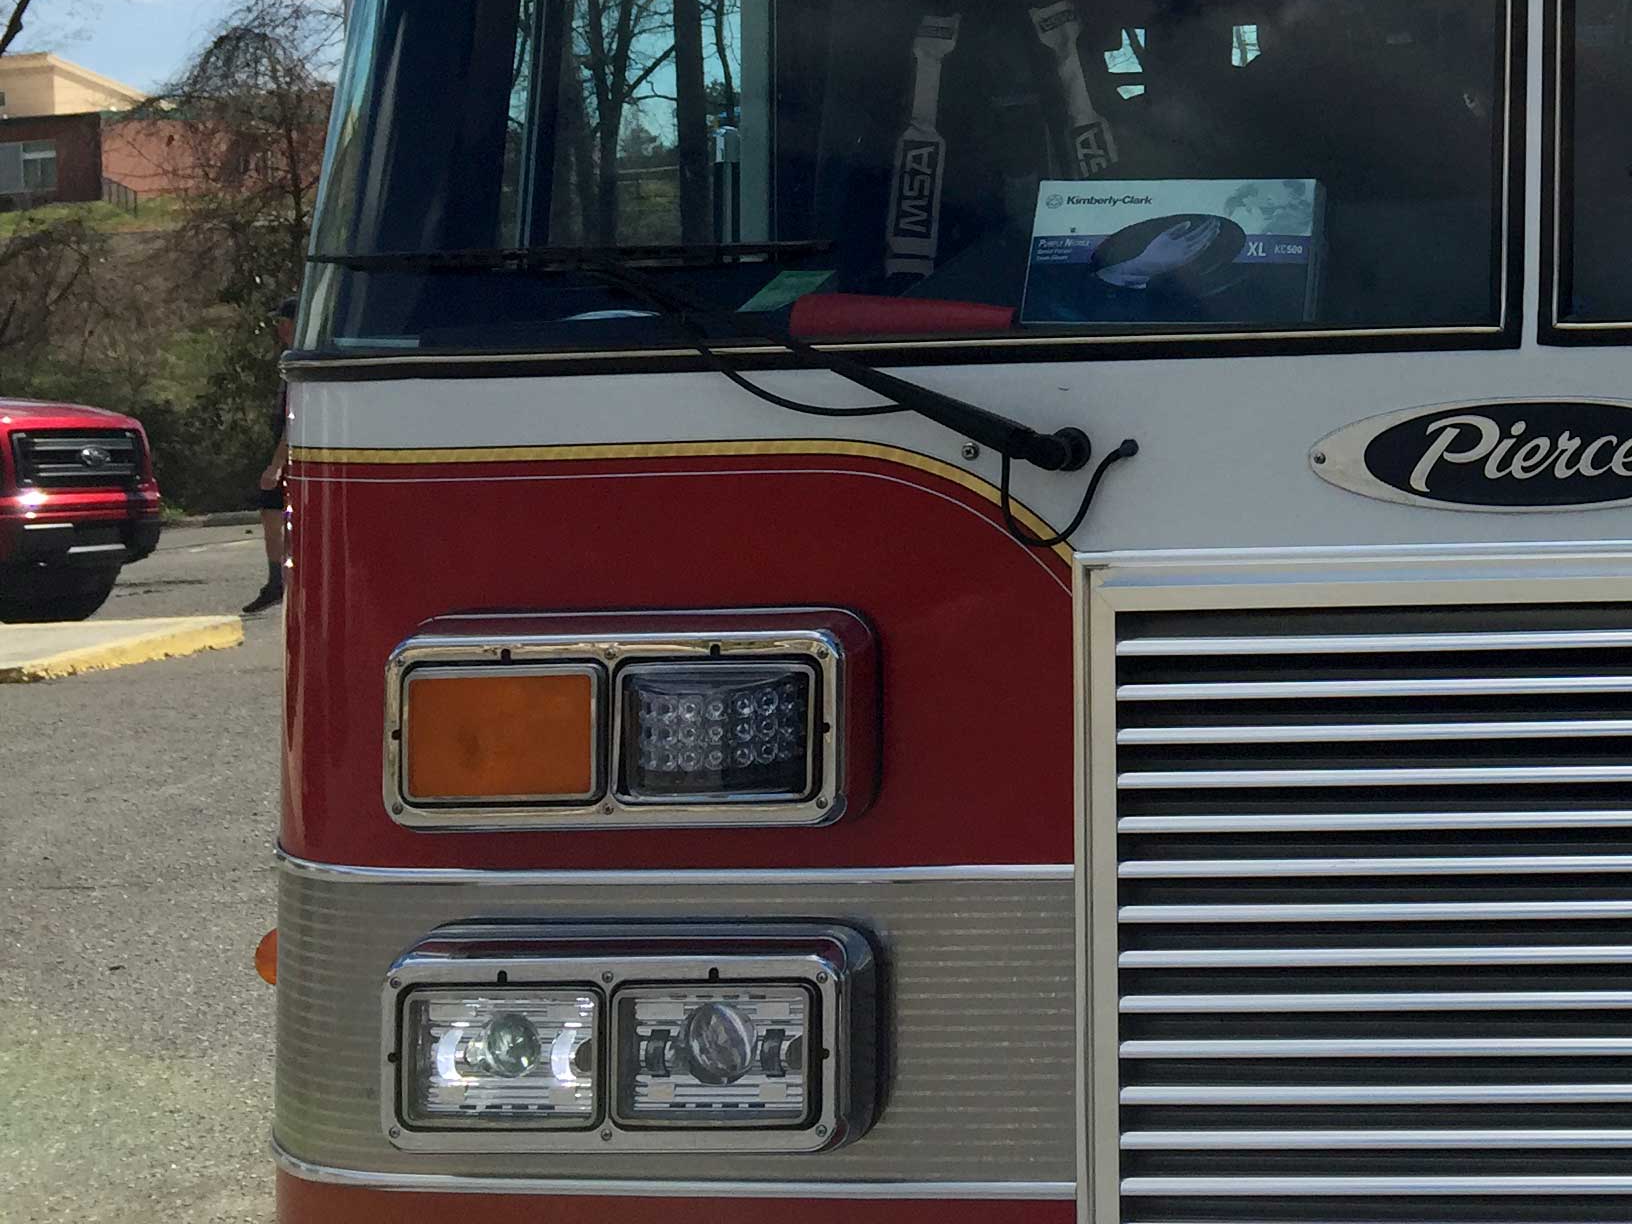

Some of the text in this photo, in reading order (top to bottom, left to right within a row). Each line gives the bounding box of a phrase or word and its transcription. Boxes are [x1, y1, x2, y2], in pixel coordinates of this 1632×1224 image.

[899, 145, 936, 234] MSA
[1065, 195, 1152, 207] Kimberly-Clark
[1247, 241, 1267, 257] XL
